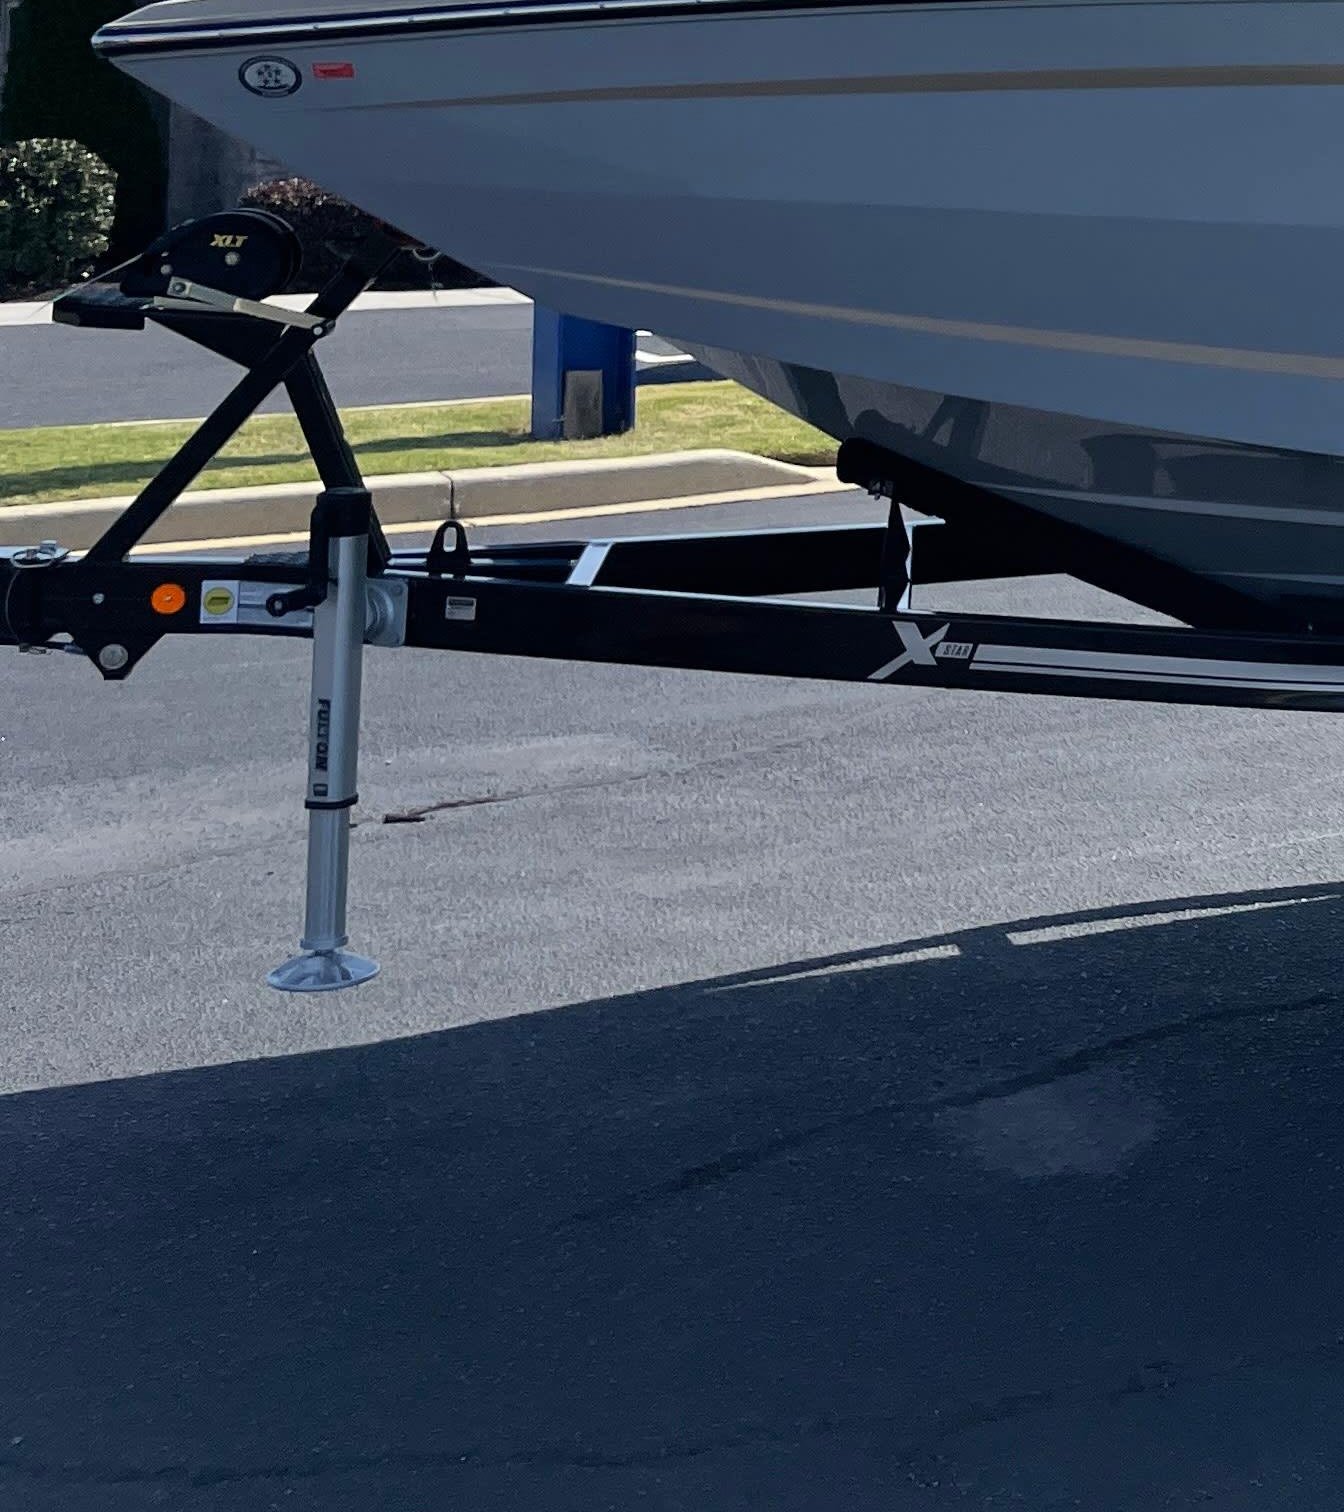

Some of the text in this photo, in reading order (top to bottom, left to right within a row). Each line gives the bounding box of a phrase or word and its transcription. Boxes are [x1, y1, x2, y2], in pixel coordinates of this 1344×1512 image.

[210, 233, 249, 248] XLT
[943, 644, 970, 657] STAR
[315, 699, 331, 771] FULTON
